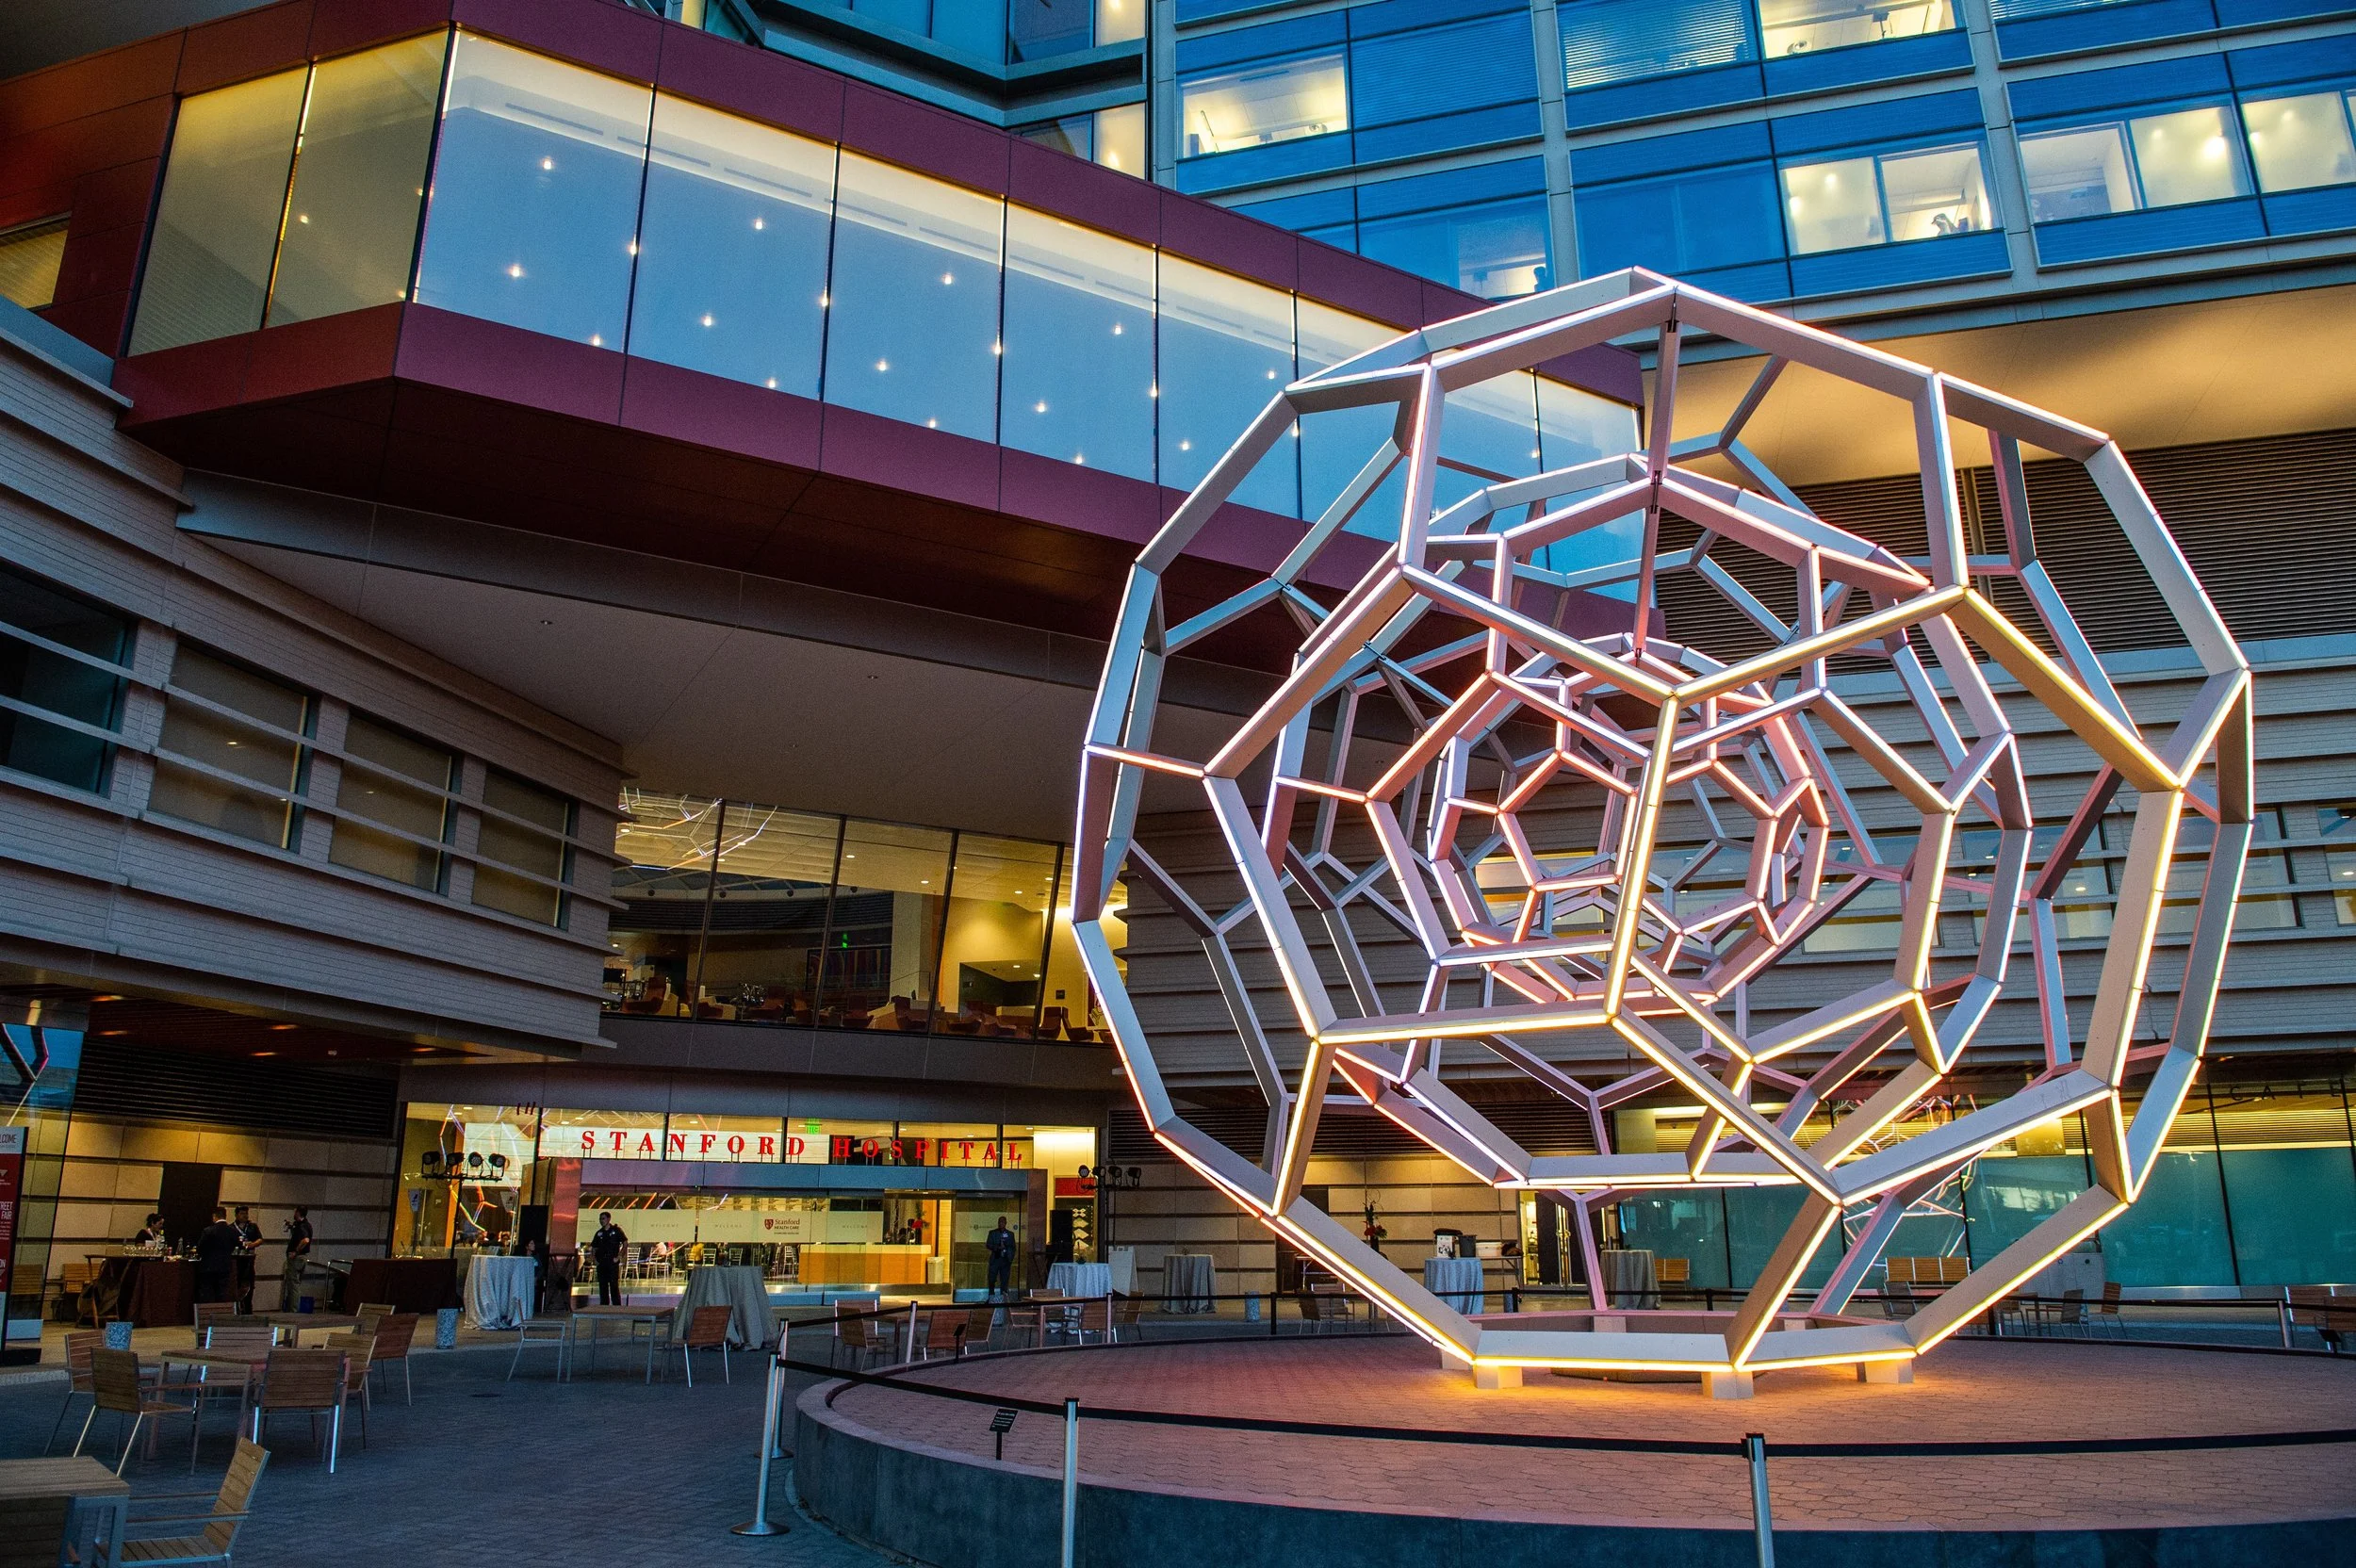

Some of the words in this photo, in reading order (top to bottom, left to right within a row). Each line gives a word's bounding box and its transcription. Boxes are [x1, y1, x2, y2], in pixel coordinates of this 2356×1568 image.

[2230, 1081, 2341, 1101] CAFE
[581, 1131, 805, 1155] STANFORD
[833, 1138, 1023, 1161] HOSPITAL
